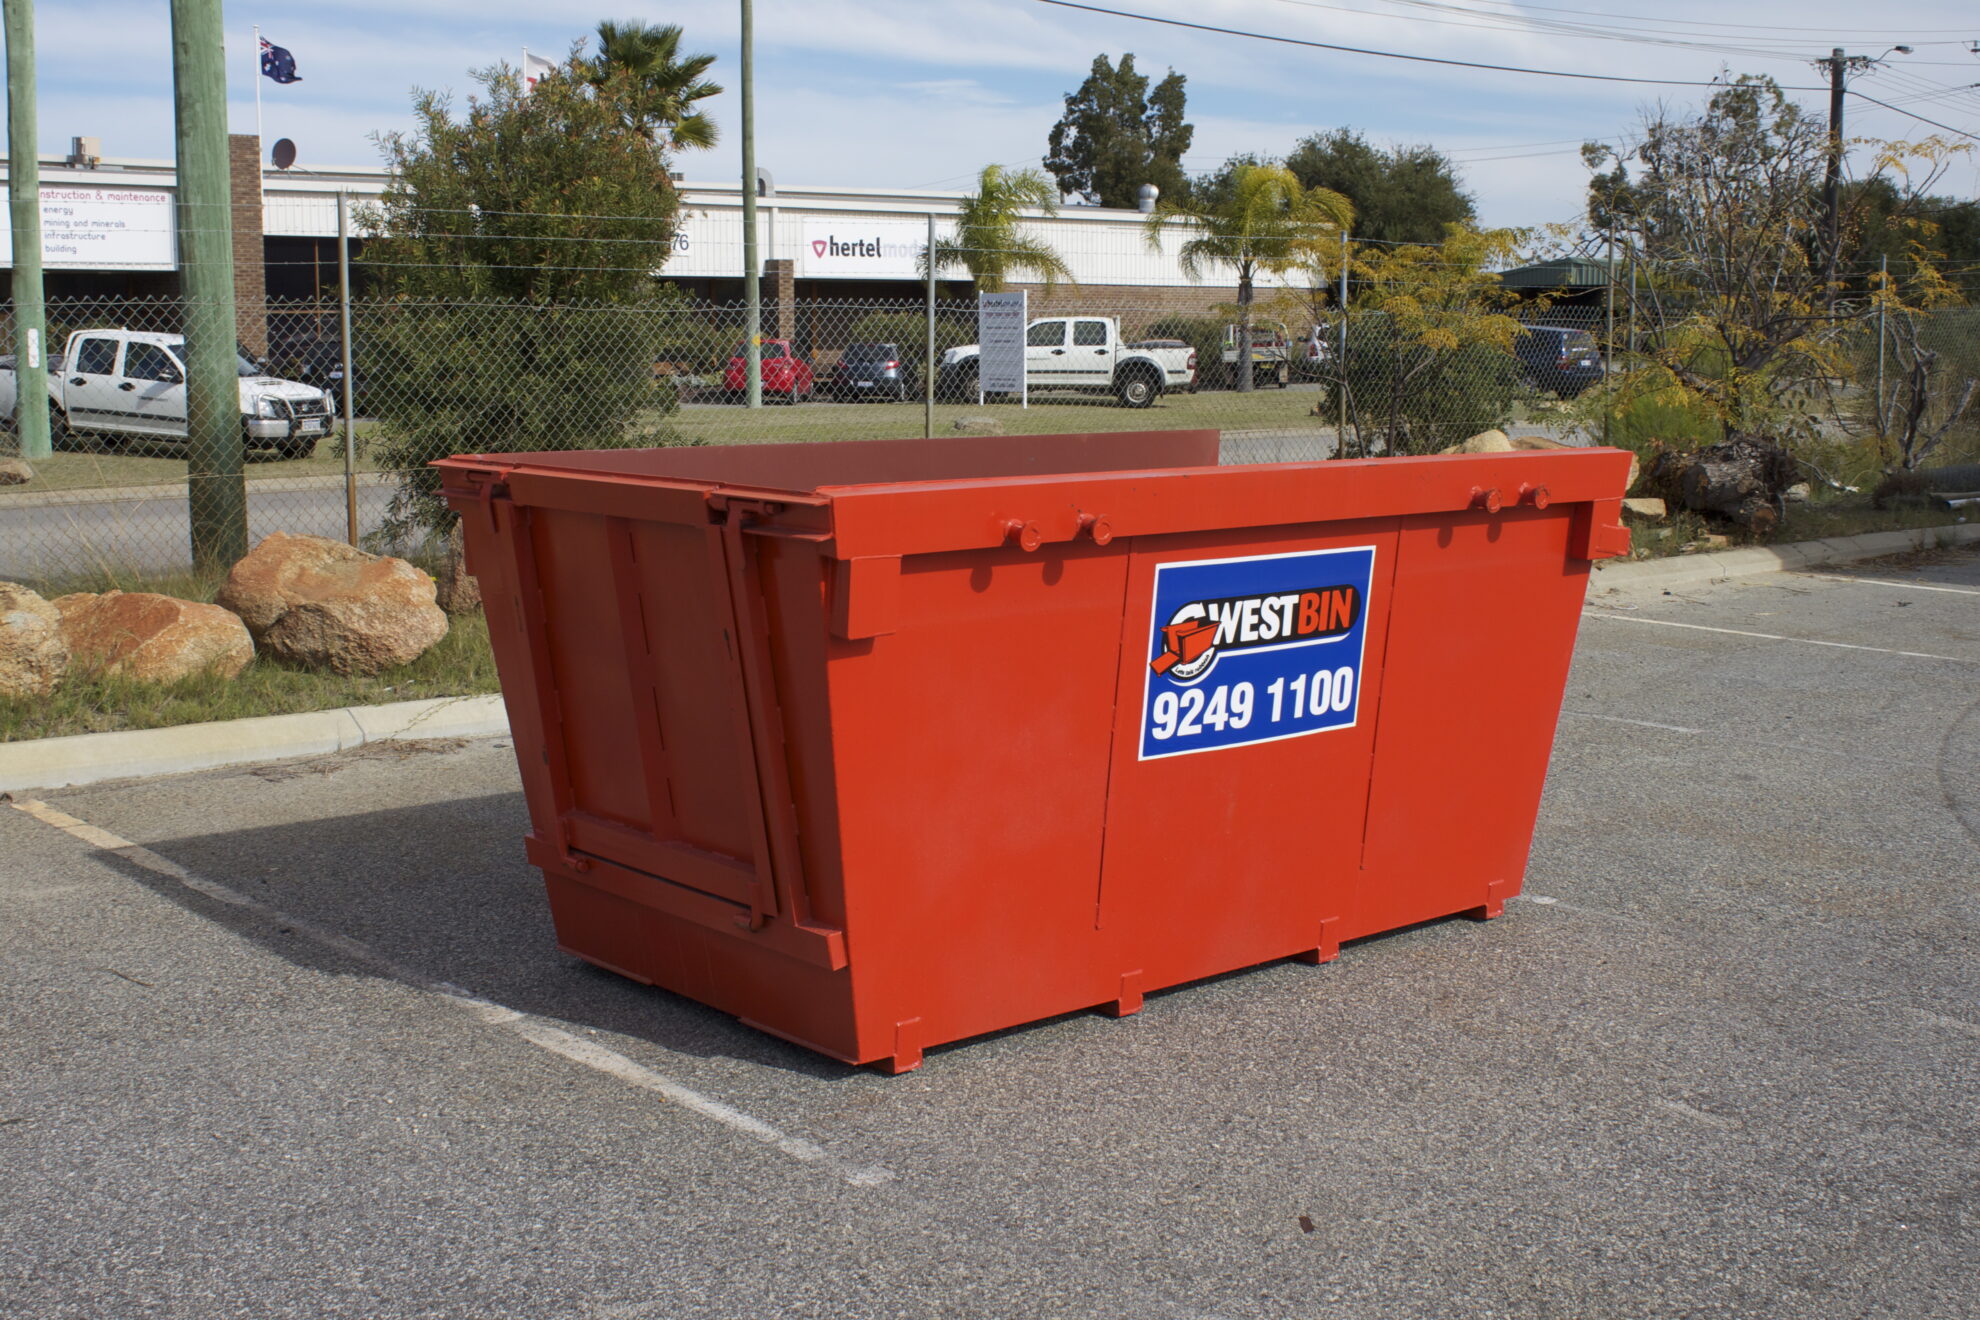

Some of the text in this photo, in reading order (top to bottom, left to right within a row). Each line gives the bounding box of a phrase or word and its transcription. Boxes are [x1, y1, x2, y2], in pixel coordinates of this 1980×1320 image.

[95, 190, 103, 200] &
[107, 192, 166, 202] maintenance
[43, 206, 74, 216] energy
[43, 219, 126, 229] mining and minerals
[44, 231, 106, 240] infrastructure
[45, 244, 77, 254] building
[1152, 666, 1354, 740] 9249 1100
